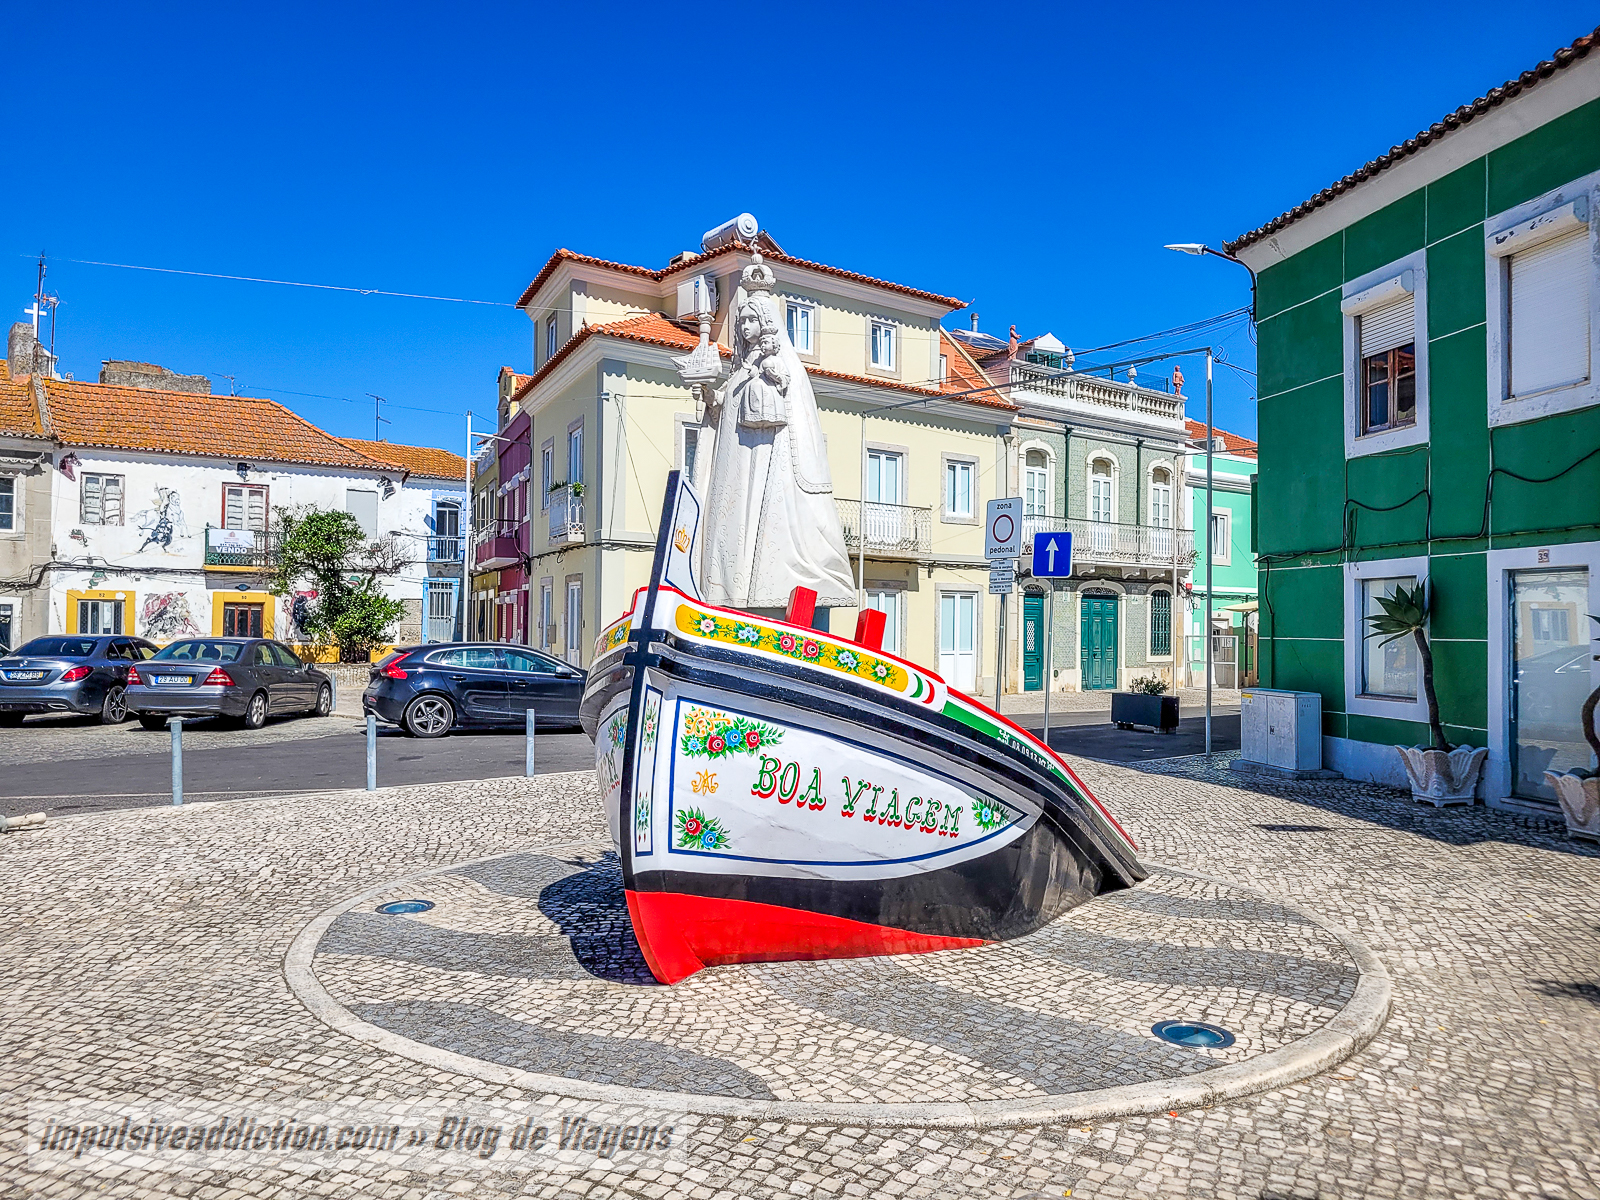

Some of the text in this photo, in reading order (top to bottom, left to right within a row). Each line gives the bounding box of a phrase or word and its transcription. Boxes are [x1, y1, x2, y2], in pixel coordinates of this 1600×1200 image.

[996, 502, 1012, 510] zona
[215, 546, 248, 554] VENDO
[989, 545, 1016, 555] pedonal
[751, 754, 963, 838] BOA VIAGEM
